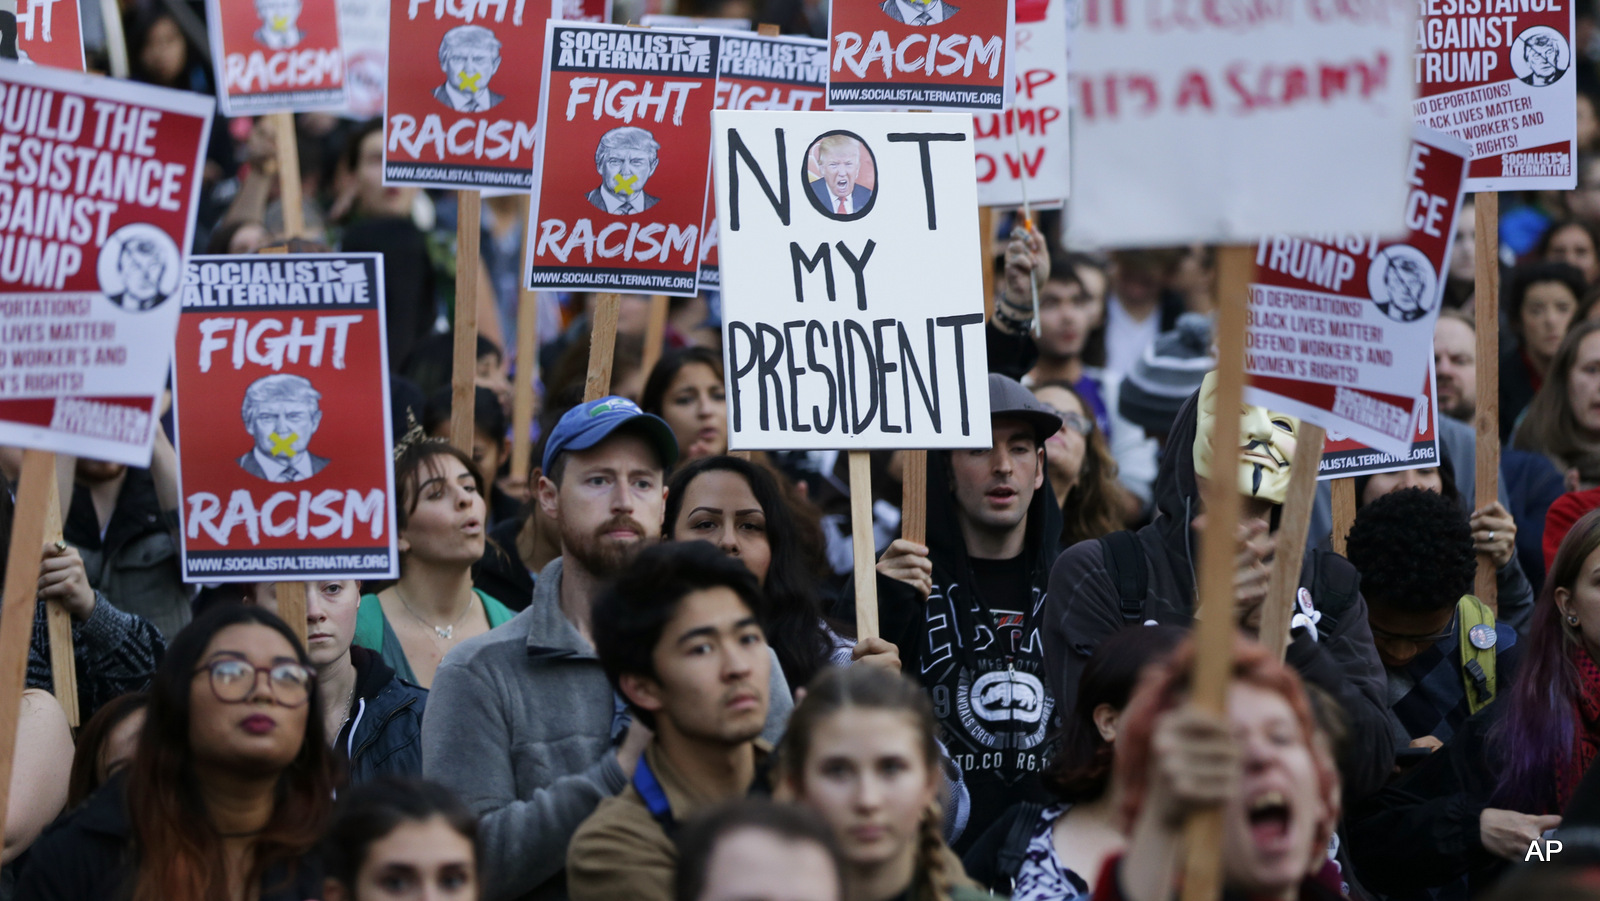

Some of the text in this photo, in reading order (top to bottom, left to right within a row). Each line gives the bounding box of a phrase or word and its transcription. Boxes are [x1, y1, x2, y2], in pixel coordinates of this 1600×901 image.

[560, 31, 681, 54] SOCIALIST
[1415, 15, 1518, 50] AGAINST
[226, 48, 343, 92] RACISM
[558, 48, 711, 73] ALTERNATIVE
[832, 30, 1003, 79] RACISM
[1412, 50, 1498, 84] TRUMP
[566, 76, 702, 127] FIGHT
[830, 88, 1001, 105] WWW.SOCIALISTALTERNATIVE.ORG
[1430, 83, 1512, 113] DEPORTATIONS!
[1453, 106, 1484, 126] LIVES
[1486, 96, 1533, 118] MATTER!
[93, 100, 163, 158] THE
[388, 113, 537, 162] RACISM
[1462, 118, 1520, 140] WORKER'S
[1522, 111, 1544, 129] AND
[1476, 134, 1519, 157] RIGHTS!
[1501, 152, 1557, 166] SOCIALIST
[727, 127, 967, 231] NOT
[1501, 163, 1571, 178] ALTERNATIVE
[536, 218, 699, 265] RACISM
[0, 233, 83, 291] UMP
[185, 261, 332, 285] SOCIALIST
[790, 238, 877, 311] MY
[1255, 232, 1356, 292] TRUMP
[181, 281, 370, 307] ALTERNATIVE
[533, 272, 694, 289] WWW.SOCIALISTALTERNATIVE.ORG
[0, 295, 91, 317] ORTATIONS!
[1246, 288, 1363, 319] NO DEPORTATIONS!
[2, 319, 116, 343] LIVES MATTER!
[1245, 310, 1384, 343] BLACK LIVES MATTER!
[95, 346, 127, 366] AND
[198, 314, 363, 373] FIGHT
[1244, 331, 1394, 368] DEFEND WORKER'S AND
[728, 313, 983, 437] PRESIDENT
[1244, 353, 1360, 384] WOMEN'S RIGHTS!
[187, 488, 386, 547] RACISM
[187, 554, 389, 572] WWW.SOCIALISTALTERNATIVE.ORG
